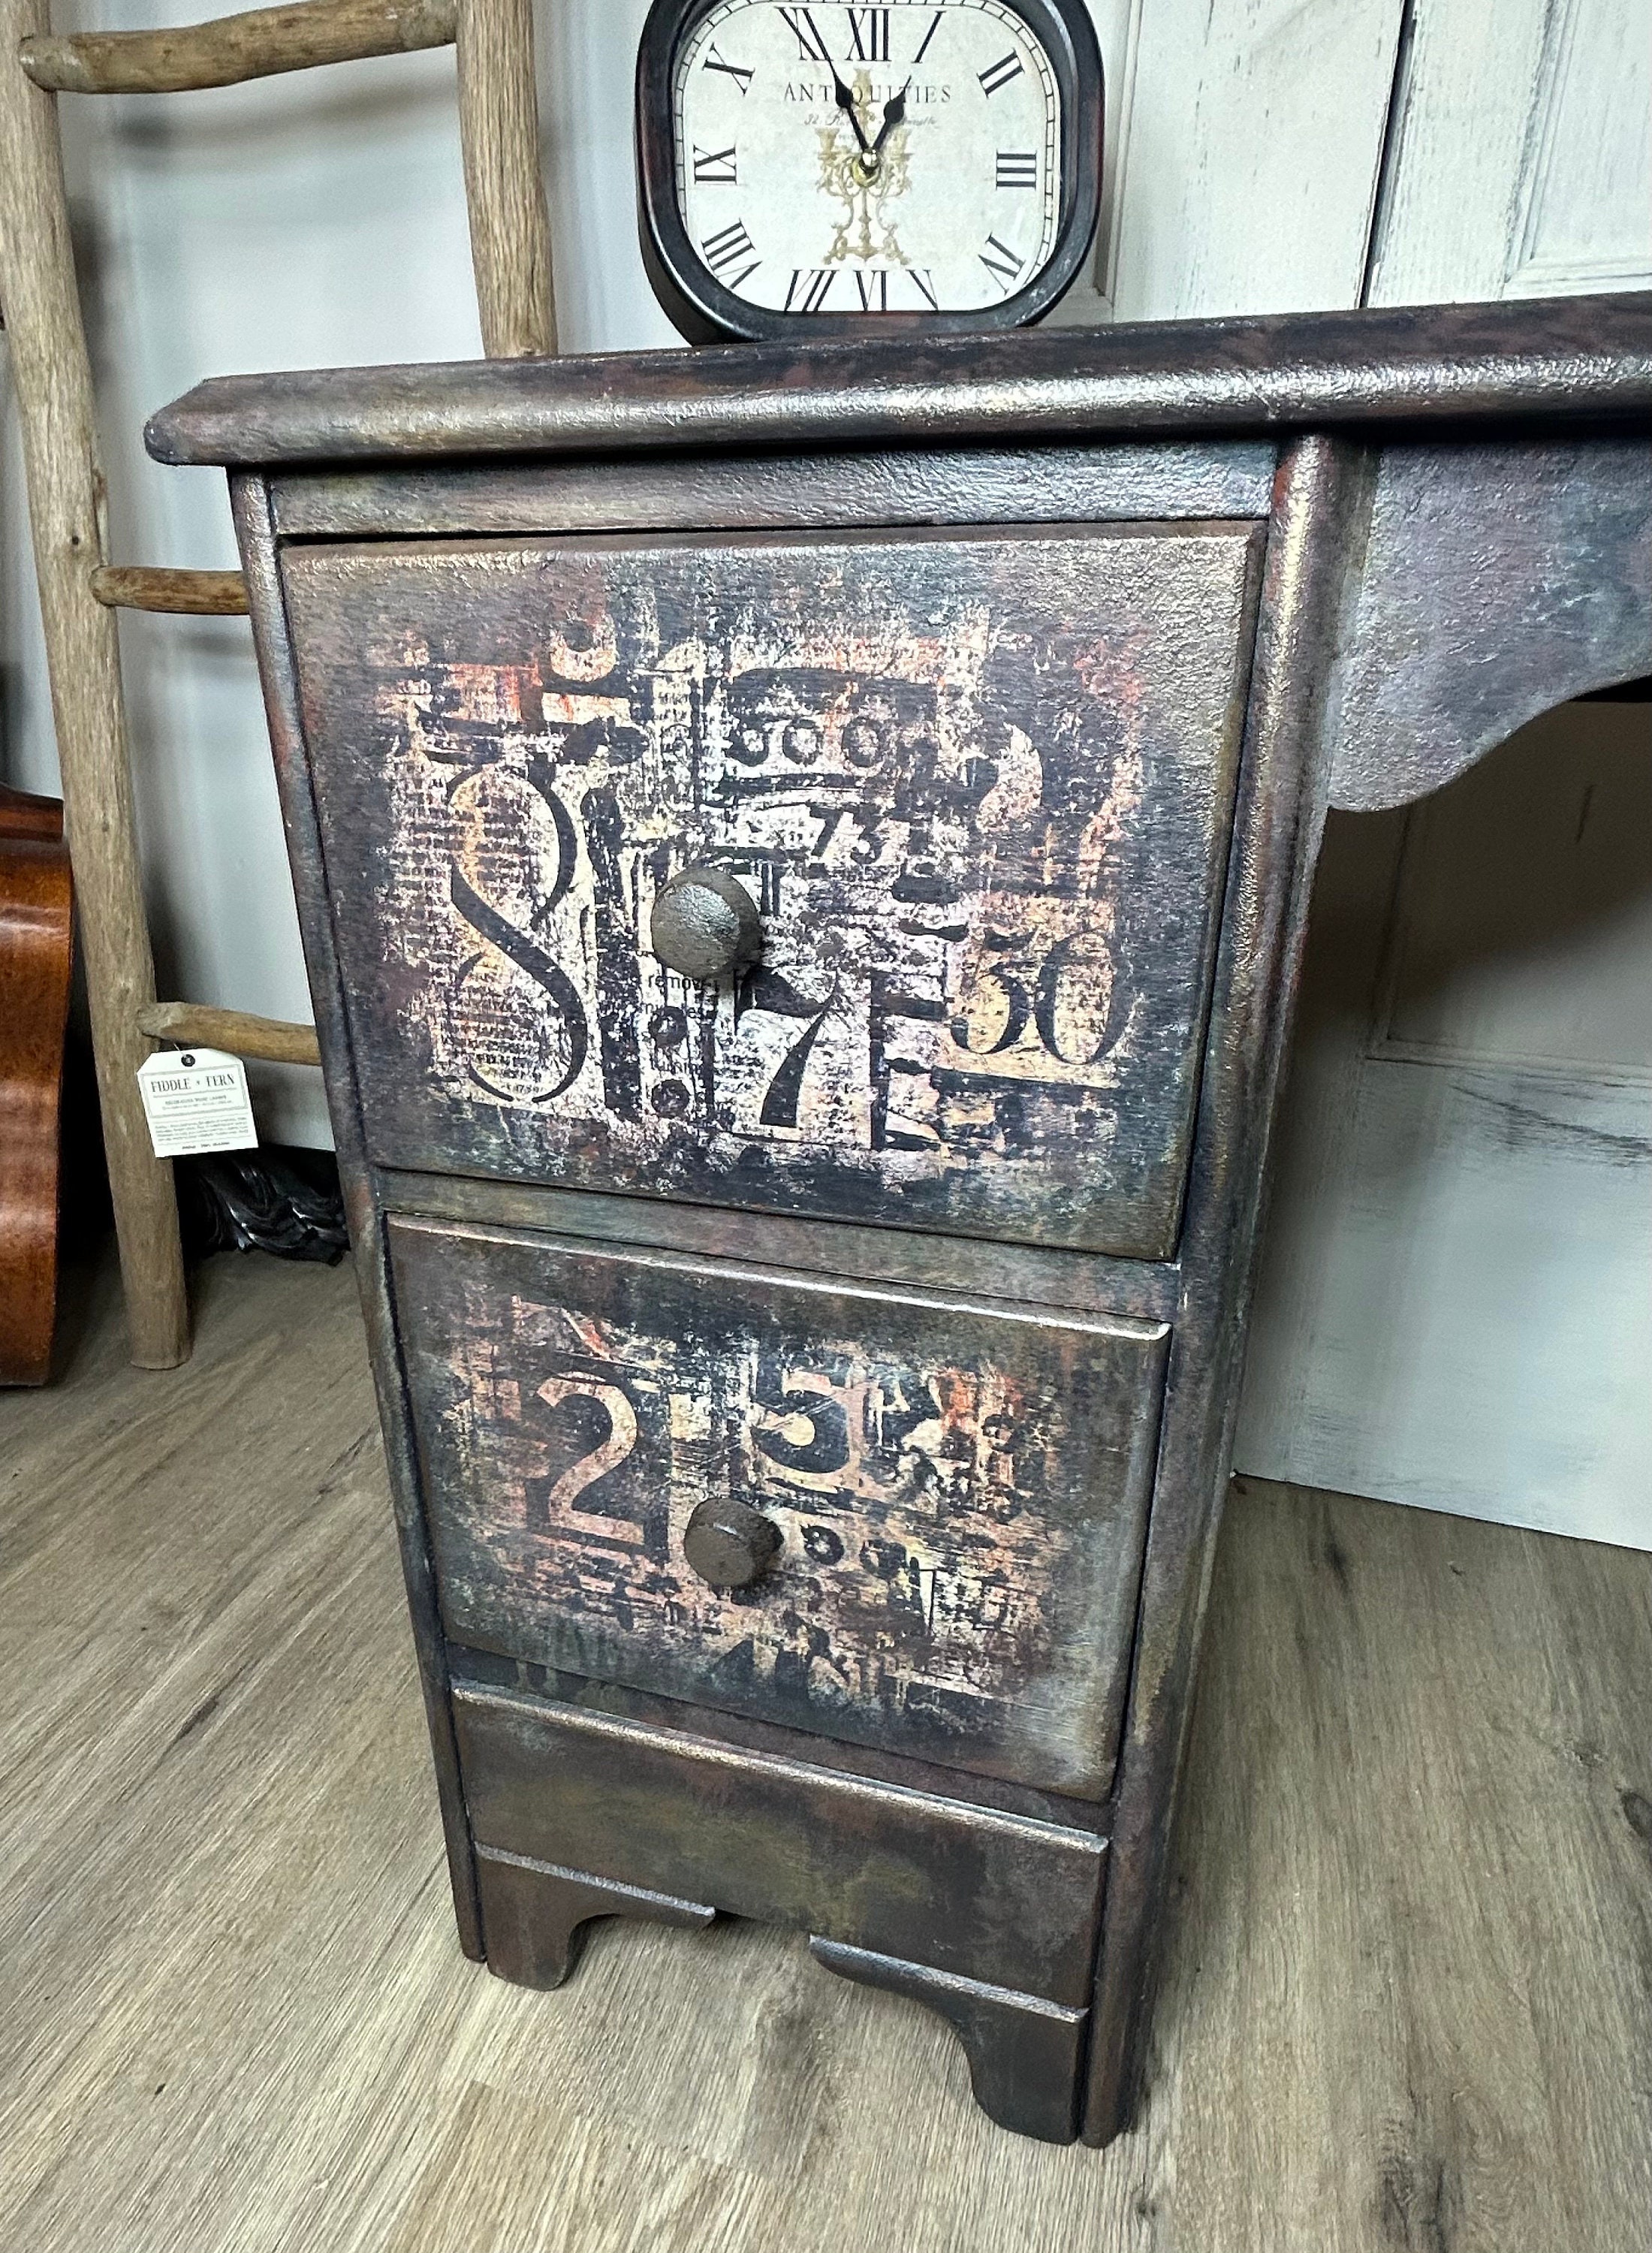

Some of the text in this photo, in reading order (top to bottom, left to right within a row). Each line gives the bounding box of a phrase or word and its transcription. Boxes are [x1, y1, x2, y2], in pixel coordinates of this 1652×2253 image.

[774, 6, 834, 62] XI
[845, 8, 891, 62] XII
[911, 10, 946, 63] I
[702, 42, 755, 96] X
[784, 83, 951, 106] ANTQUITIES
[976, 47, 1025, 99] II
[693, 144, 737, 185] IX
[996, 149, 1037, 191] III
[701, 217, 763, 290] VIII
[784, 269, 840, 312] VII
[853, 269, 888, 312] VI
[905, 269, 939, 312] V
[949, 922, 1128, 1065] 50
[731, 964, 837, 1129] 7
[150, 1078, 191, 1093] FIDDLE
[535, 1371, 645, 1546] 2
